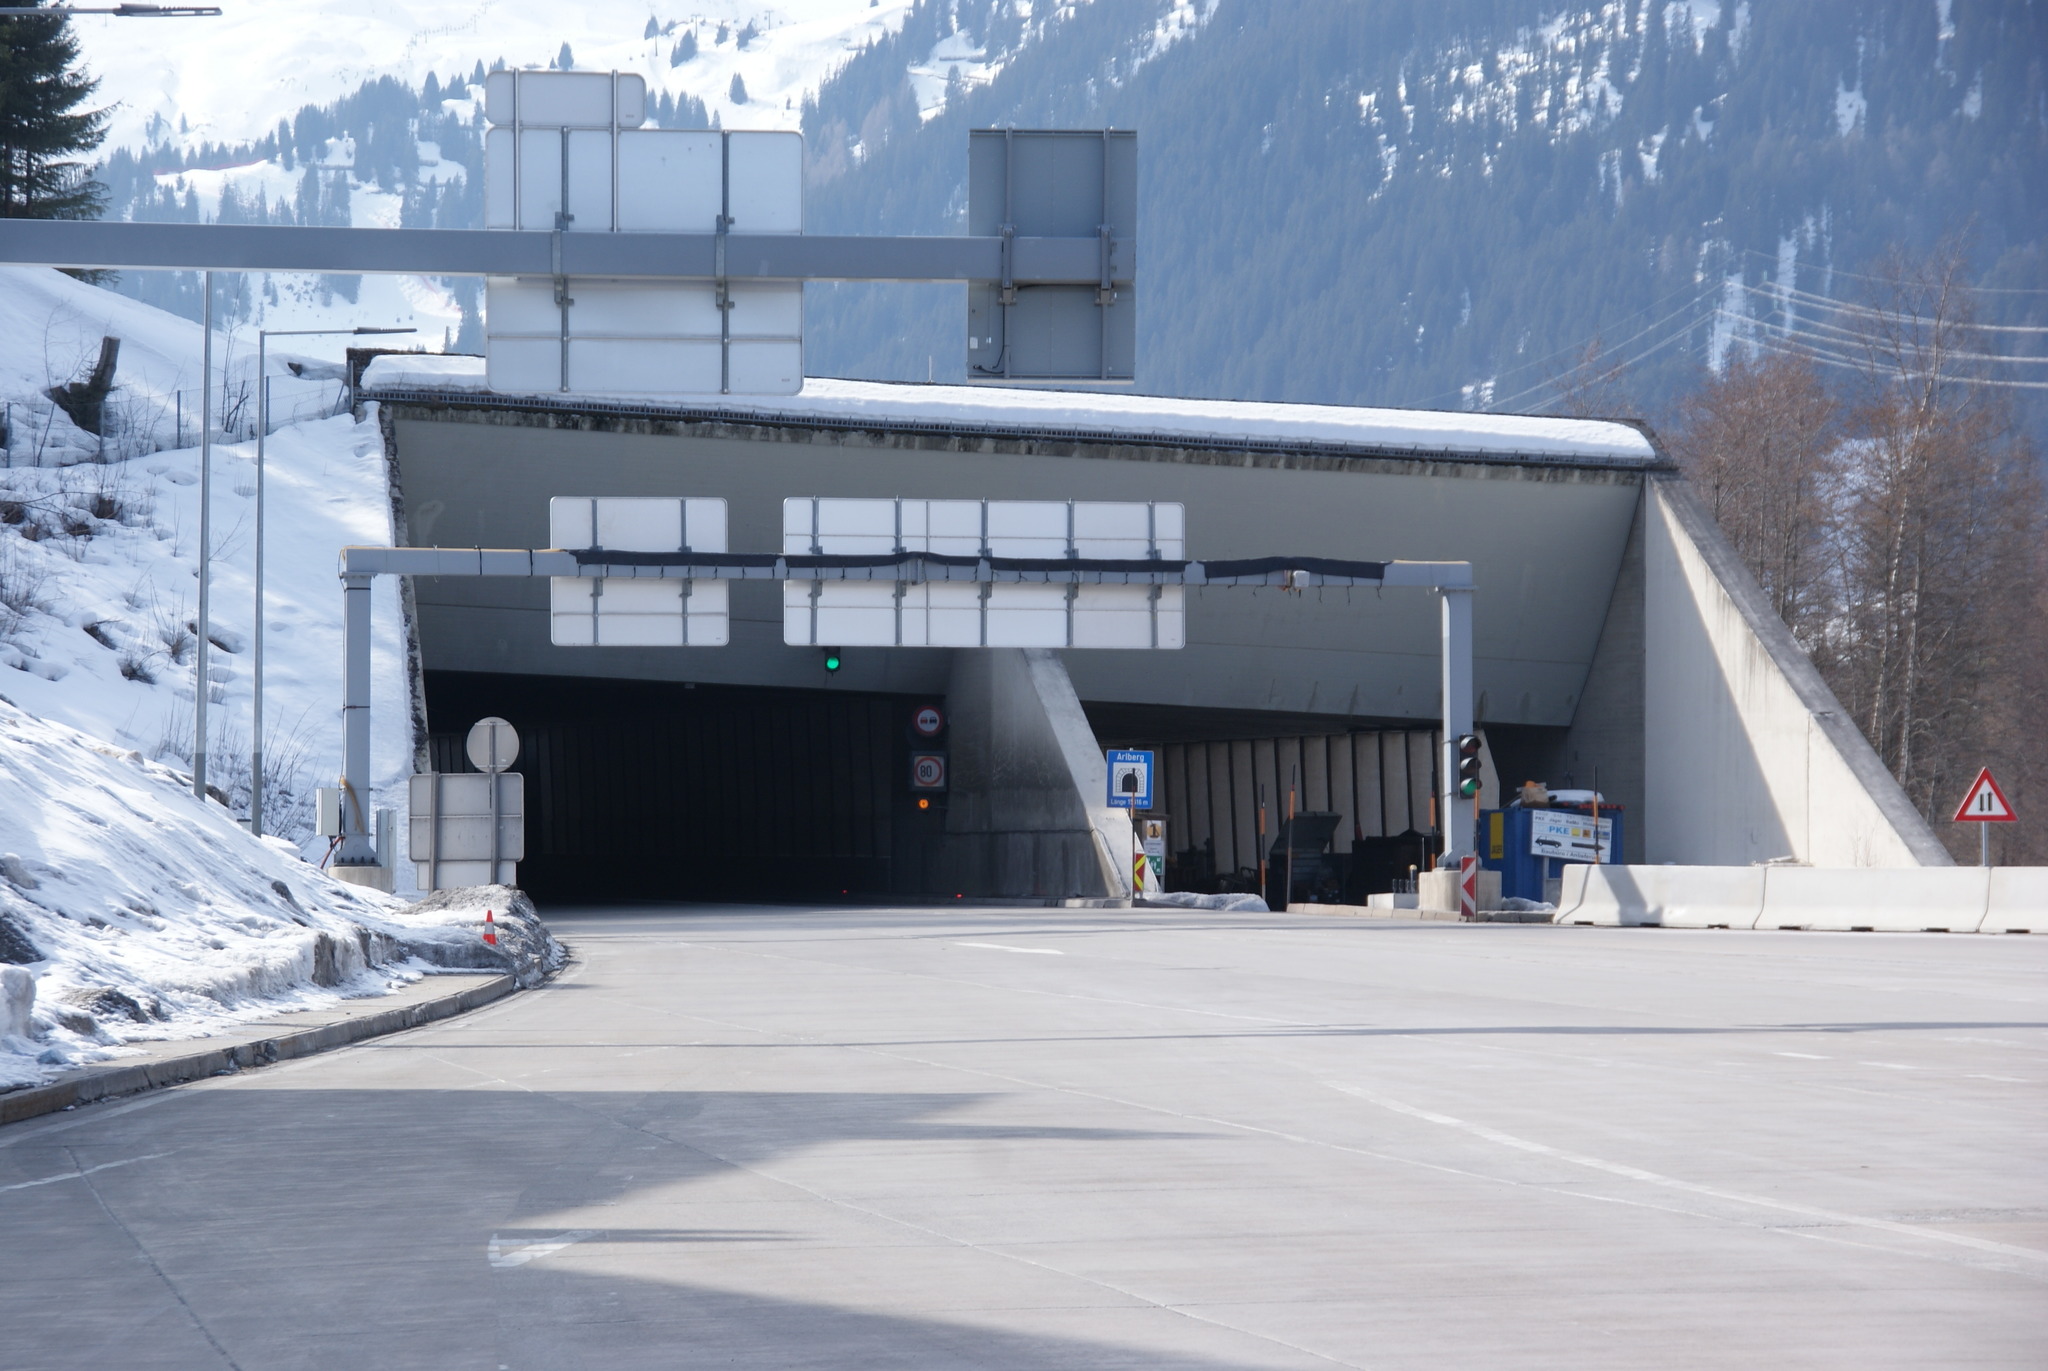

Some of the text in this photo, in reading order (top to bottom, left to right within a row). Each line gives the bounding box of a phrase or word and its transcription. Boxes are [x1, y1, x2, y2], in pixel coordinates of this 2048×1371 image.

[1117, 752, 1144, 763] Arlberg
[920, 765, 932, 777] 80
[1111, 798, 1126, 806] Länge
[1549, 825, 1569, 835] PKE
[1570, 852, 1602, 861] Anlieferug
